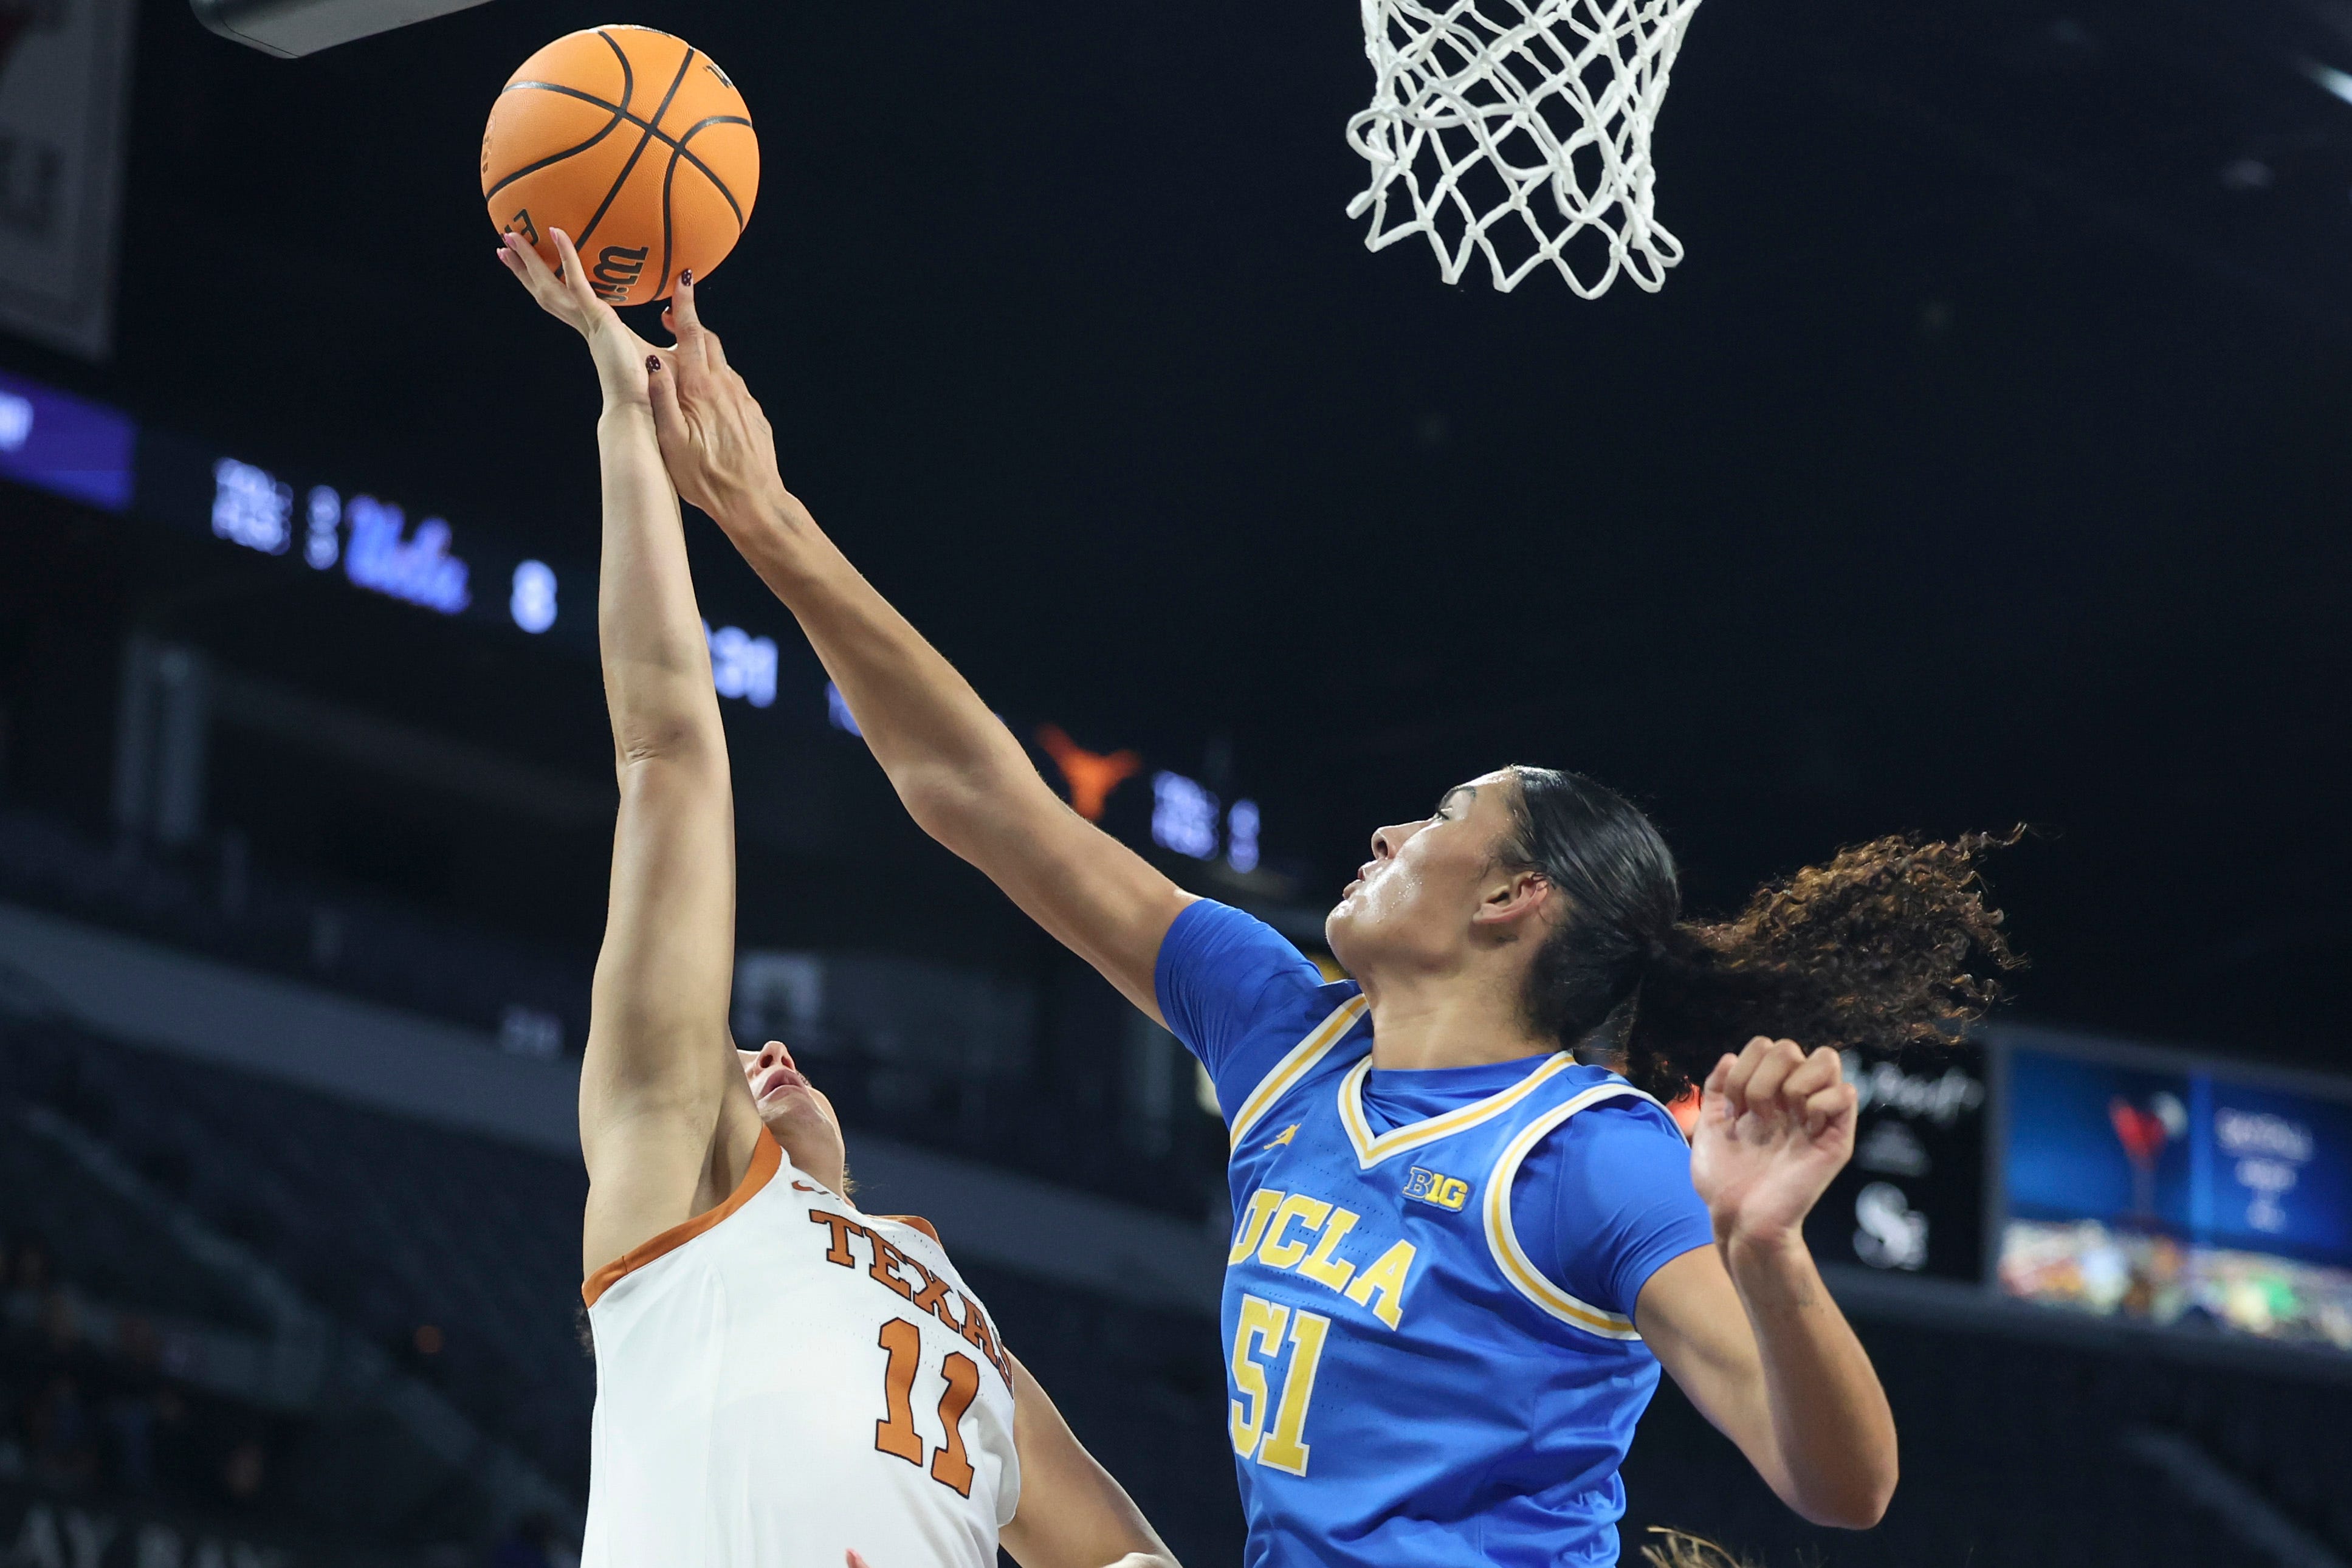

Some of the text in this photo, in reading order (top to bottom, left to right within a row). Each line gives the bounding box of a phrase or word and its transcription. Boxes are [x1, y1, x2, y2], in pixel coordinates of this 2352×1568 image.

[1228, 1188, 1417, 1332] UCLA
[875, 1317, 979, 1499] 11
[1231, 1293, 1331, 1477] 51
